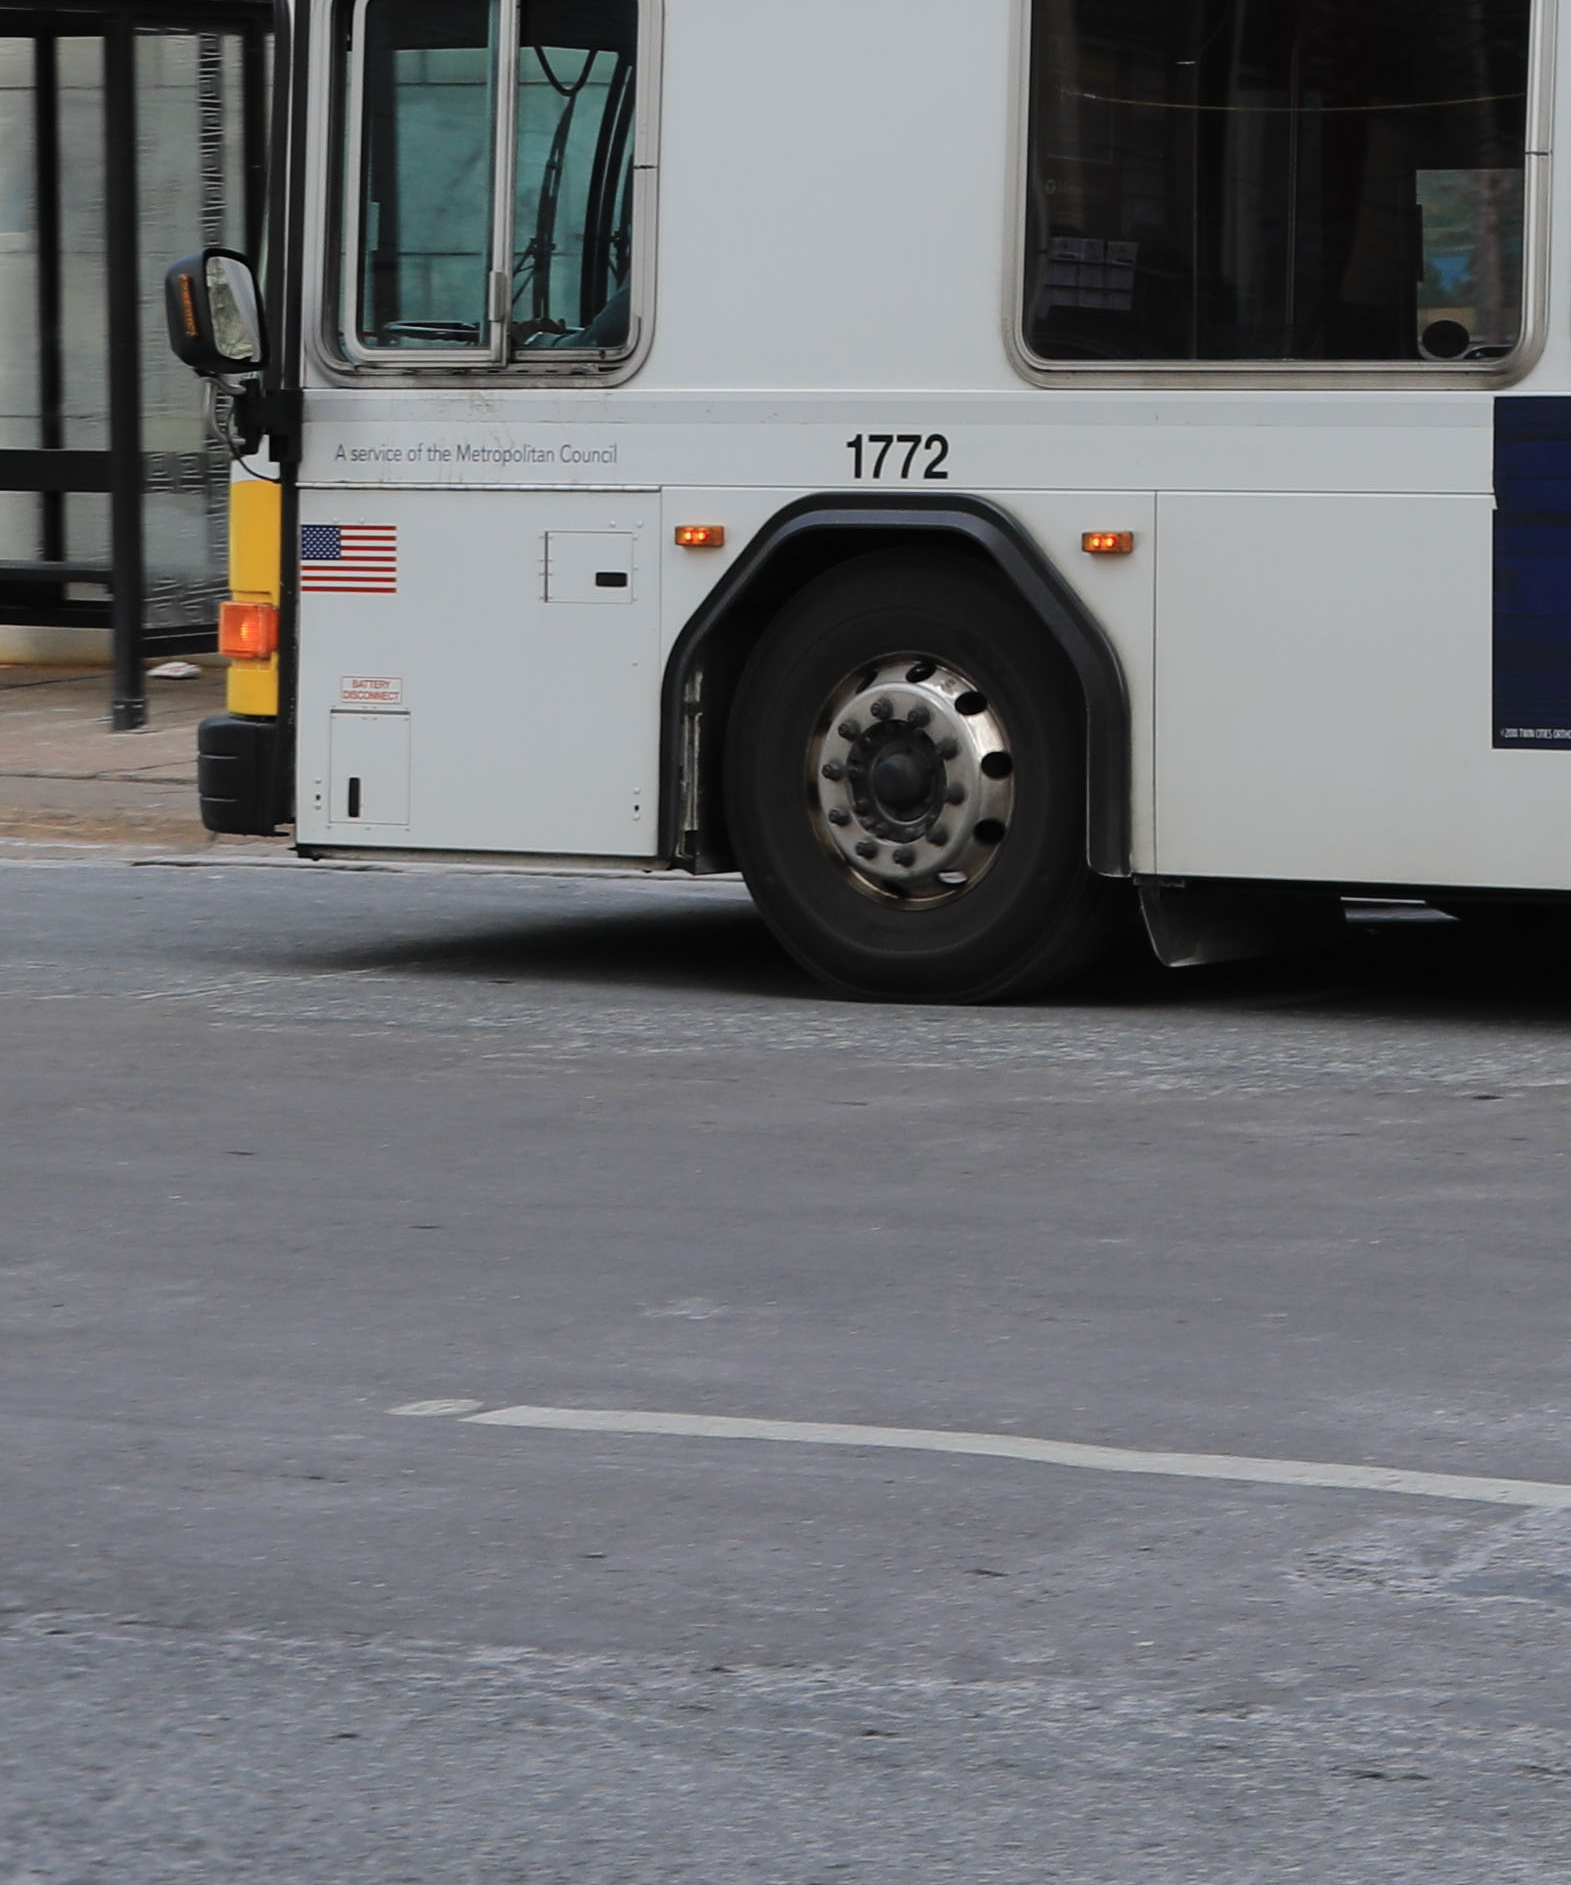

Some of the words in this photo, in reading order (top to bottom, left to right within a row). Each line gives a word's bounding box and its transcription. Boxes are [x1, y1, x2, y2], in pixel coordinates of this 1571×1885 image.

[333, 443, 348, 463] A
[350, 443, 403, 463] service
[407, 443, 424, 463] of
[426, 444, 452, 463] the
[456, 443, 555, 467] Metropolitan
[559, 443, 618, 464] Council
[846, 433, 949, 480] 1772
[352, 679, 391, 689] BATTERY
[342, 690, 400, 700] DISCONNECT
